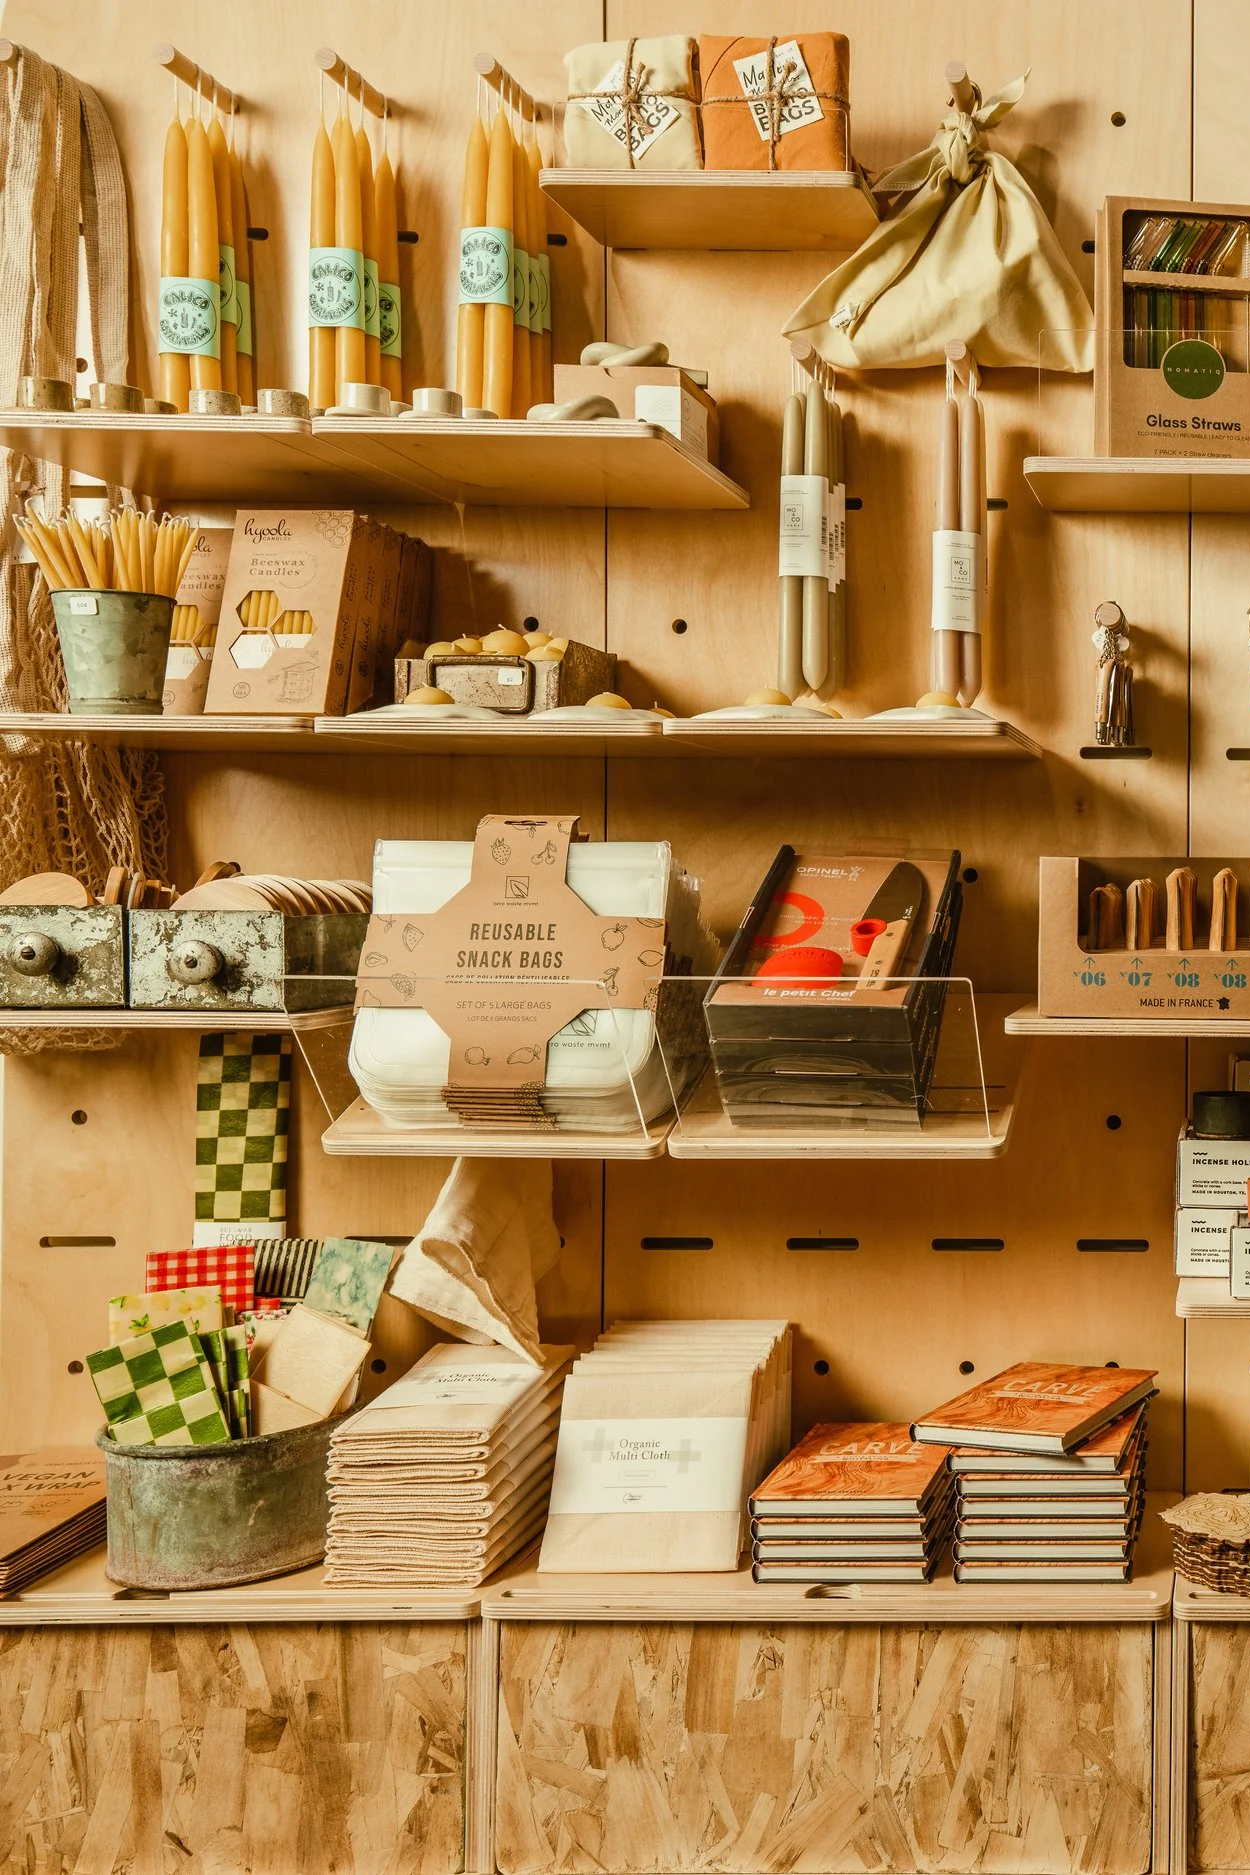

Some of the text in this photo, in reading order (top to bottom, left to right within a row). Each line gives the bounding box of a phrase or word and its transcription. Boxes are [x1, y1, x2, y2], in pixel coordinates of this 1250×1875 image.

[462, 236, 500, 256] CALICO
[312, 263, 353, 281] CALICO
[163, 290, 210, 310] CALICO
[309, 293, 355, 321] BOTANICALS
[160, 319, 210, 347] BOTANICALS
[1167, 367, 1221, 375] NOMATIQ
[1146, 414, 1241, 432] Glass Straws
[1137, 430, 1177, 439] ECO-FRIENDLY
[1180, 432, 1208, 440] REUSABLE
[244, 518, 293, 544] hyoola
[251, 558, 305, 566] Beeswax
[249, 568, 300, 576] Candles
[180, 581, 221, 590] andles
[797, 866, 847, 876] OPINEL
[469, 922, 557, 941] REUSABLE
[456, 950, 564, 969] SNACK BAGS
[763, 988, 777, 996] le
[780, 989, 811, 997] petit
[821, 990, 857, 998] Chef
[456, 1001, 552, 1009] SET OF 5 LARGE BAGS
[1140, 998, 1214, 1008] MADE IN FRANCE
[219, 1233, 253, 1241] FOOD
[1003, 1379, 1110, 1397] CARVE
[619, 1438, 661, 1450] Organic
[819, 1441, 928, 1456] CARVE
[608, 1450, 671, 1461] Multi Cloth
[3, 1471, 96, 1481] VEGAN
[24, 1481, 101, 1490] WRAP
